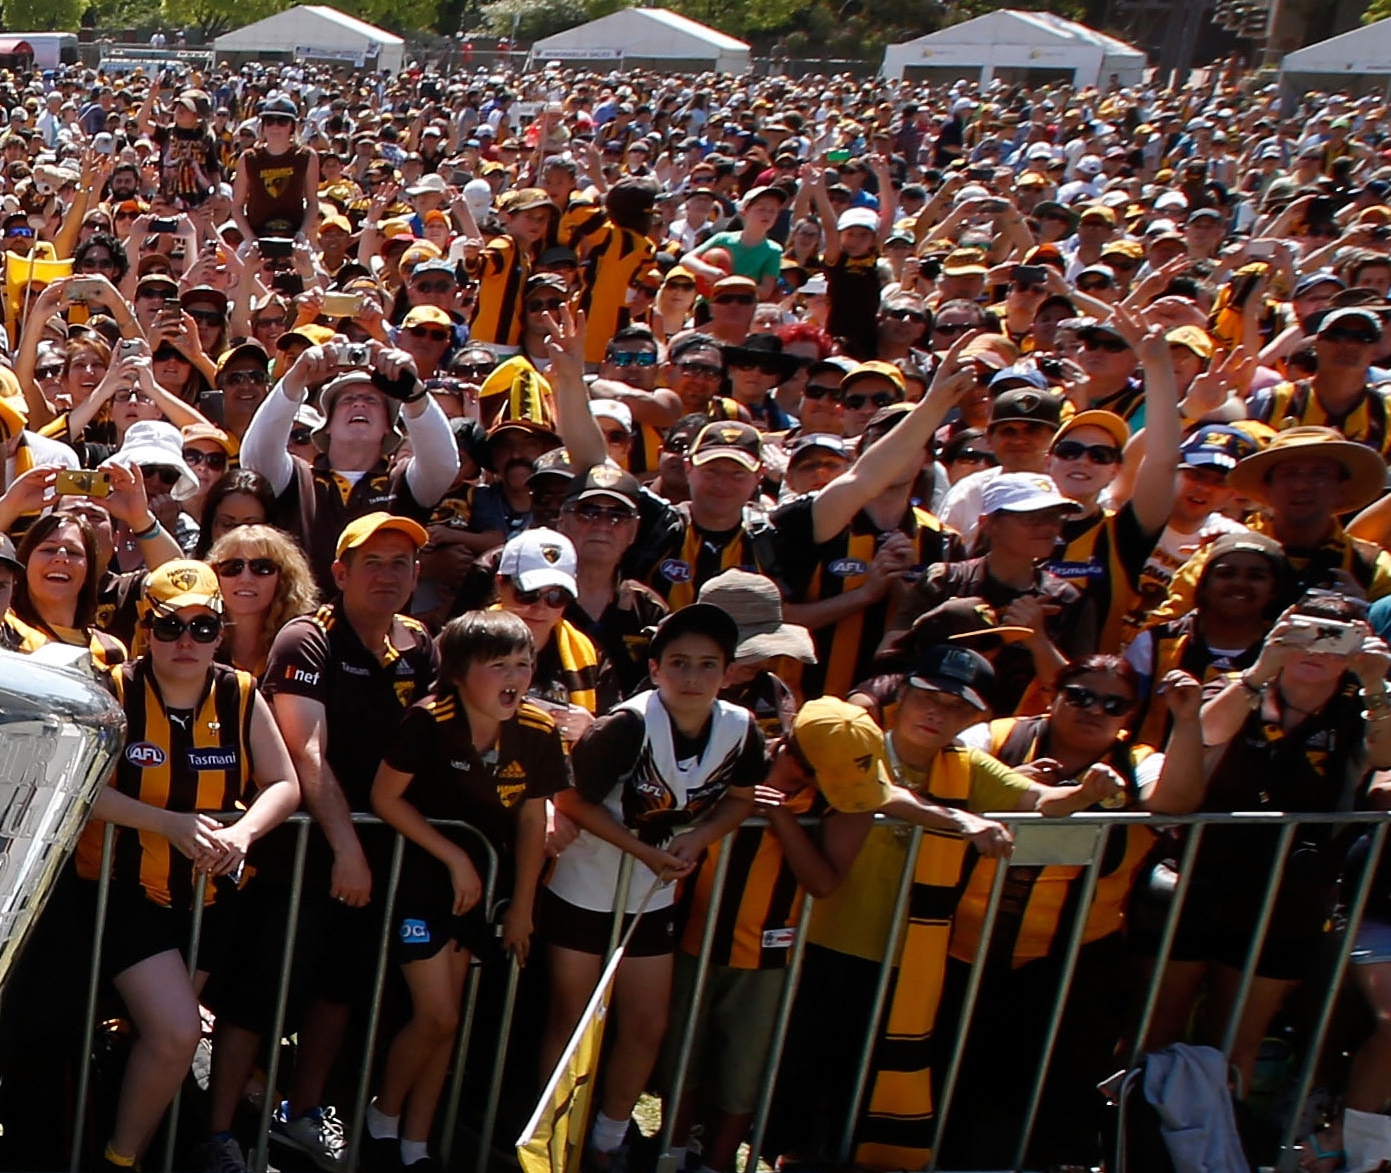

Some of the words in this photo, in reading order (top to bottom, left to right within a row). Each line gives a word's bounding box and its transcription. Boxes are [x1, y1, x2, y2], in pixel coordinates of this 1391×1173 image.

[663, 566, 690, 579] AFL
[833, 562, 863, 573] AFL
[129, 746, 165, 763] AFL
[188, 752, 237, 767] Tasmani
[638, 783, 663, 797] AFL
